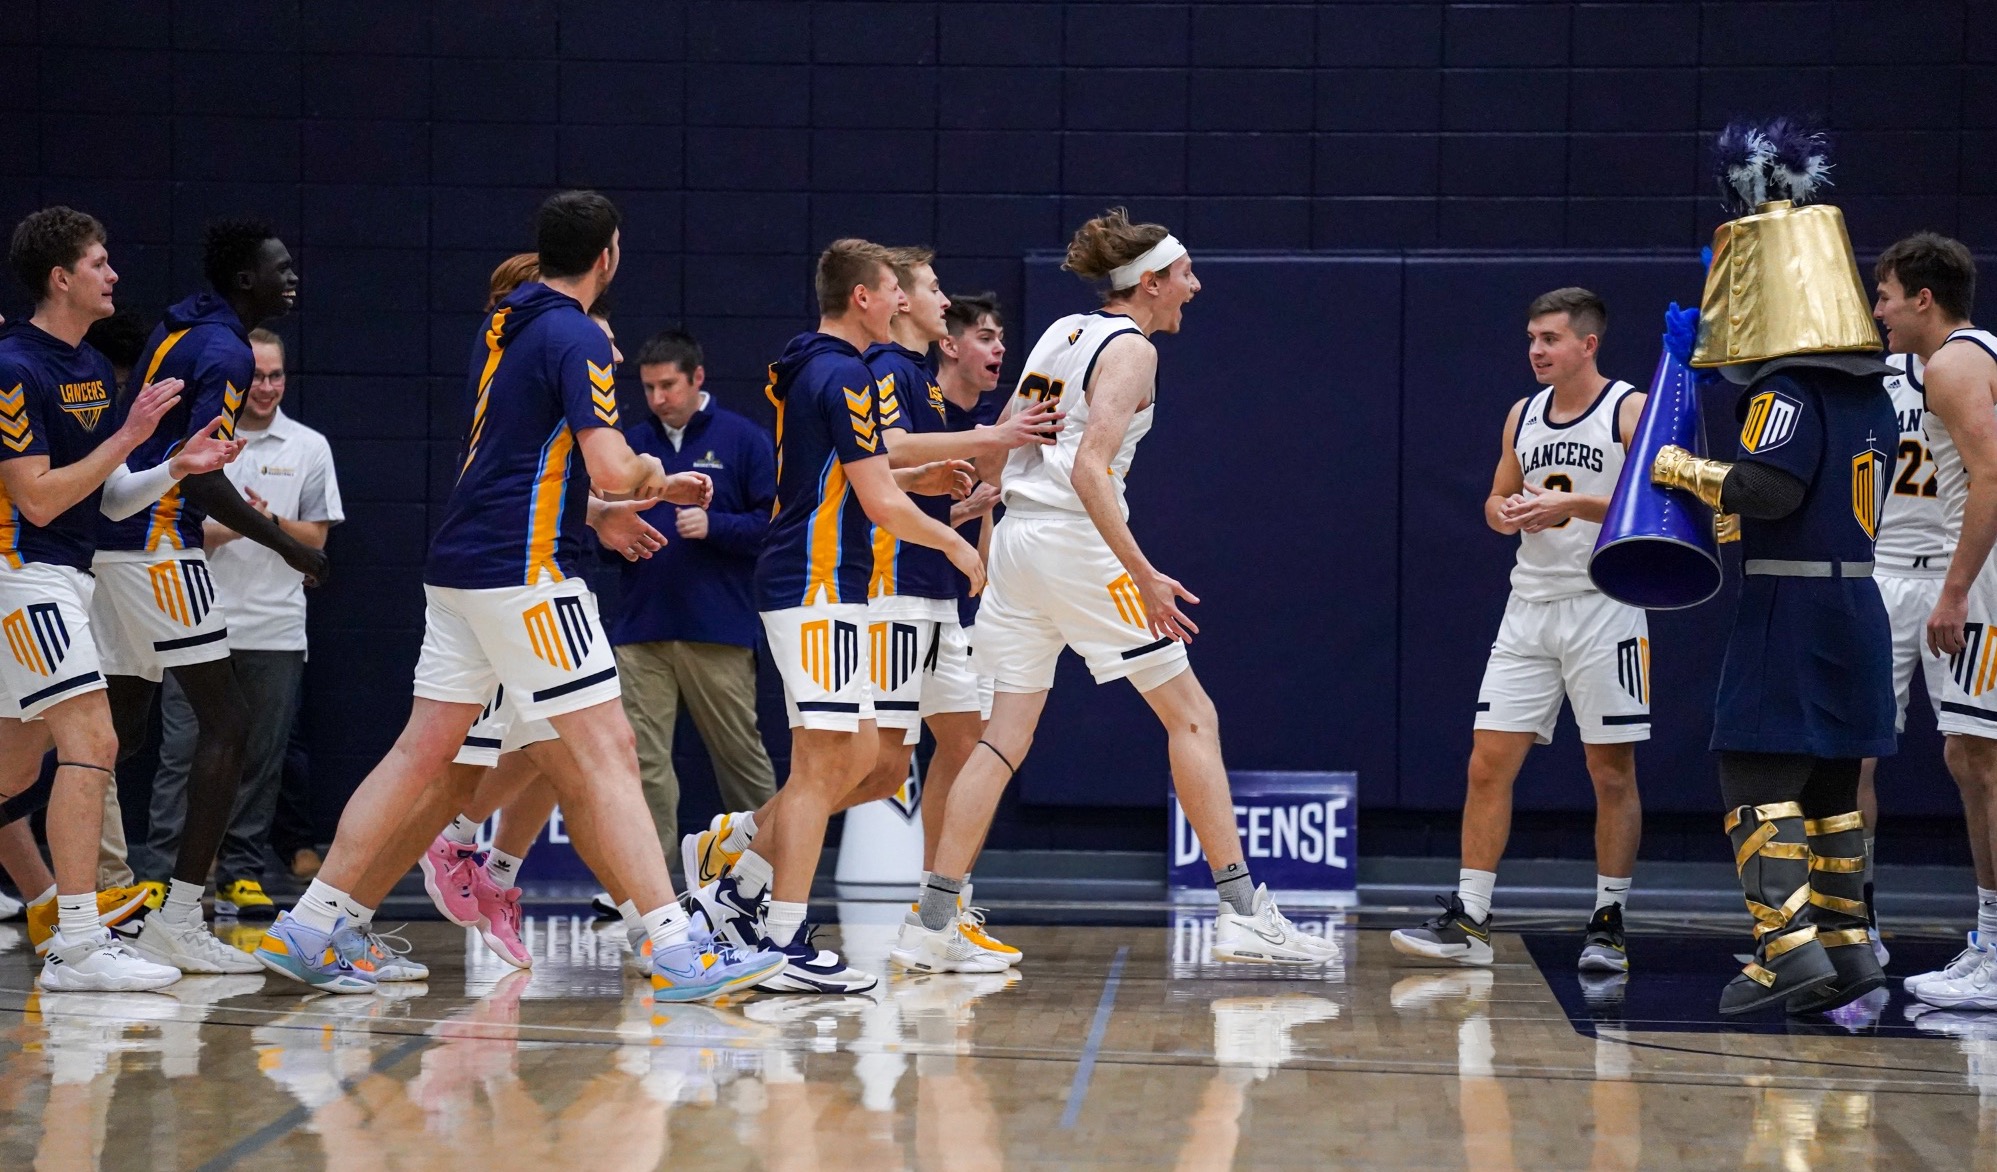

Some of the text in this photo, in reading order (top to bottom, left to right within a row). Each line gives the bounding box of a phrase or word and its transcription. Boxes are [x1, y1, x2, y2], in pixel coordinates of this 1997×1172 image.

[59, 380, 107, 403] LANCERS
[1522, 442, 1604, 474] LANCERS
[1174, 797, 1348, 870] DENSE
